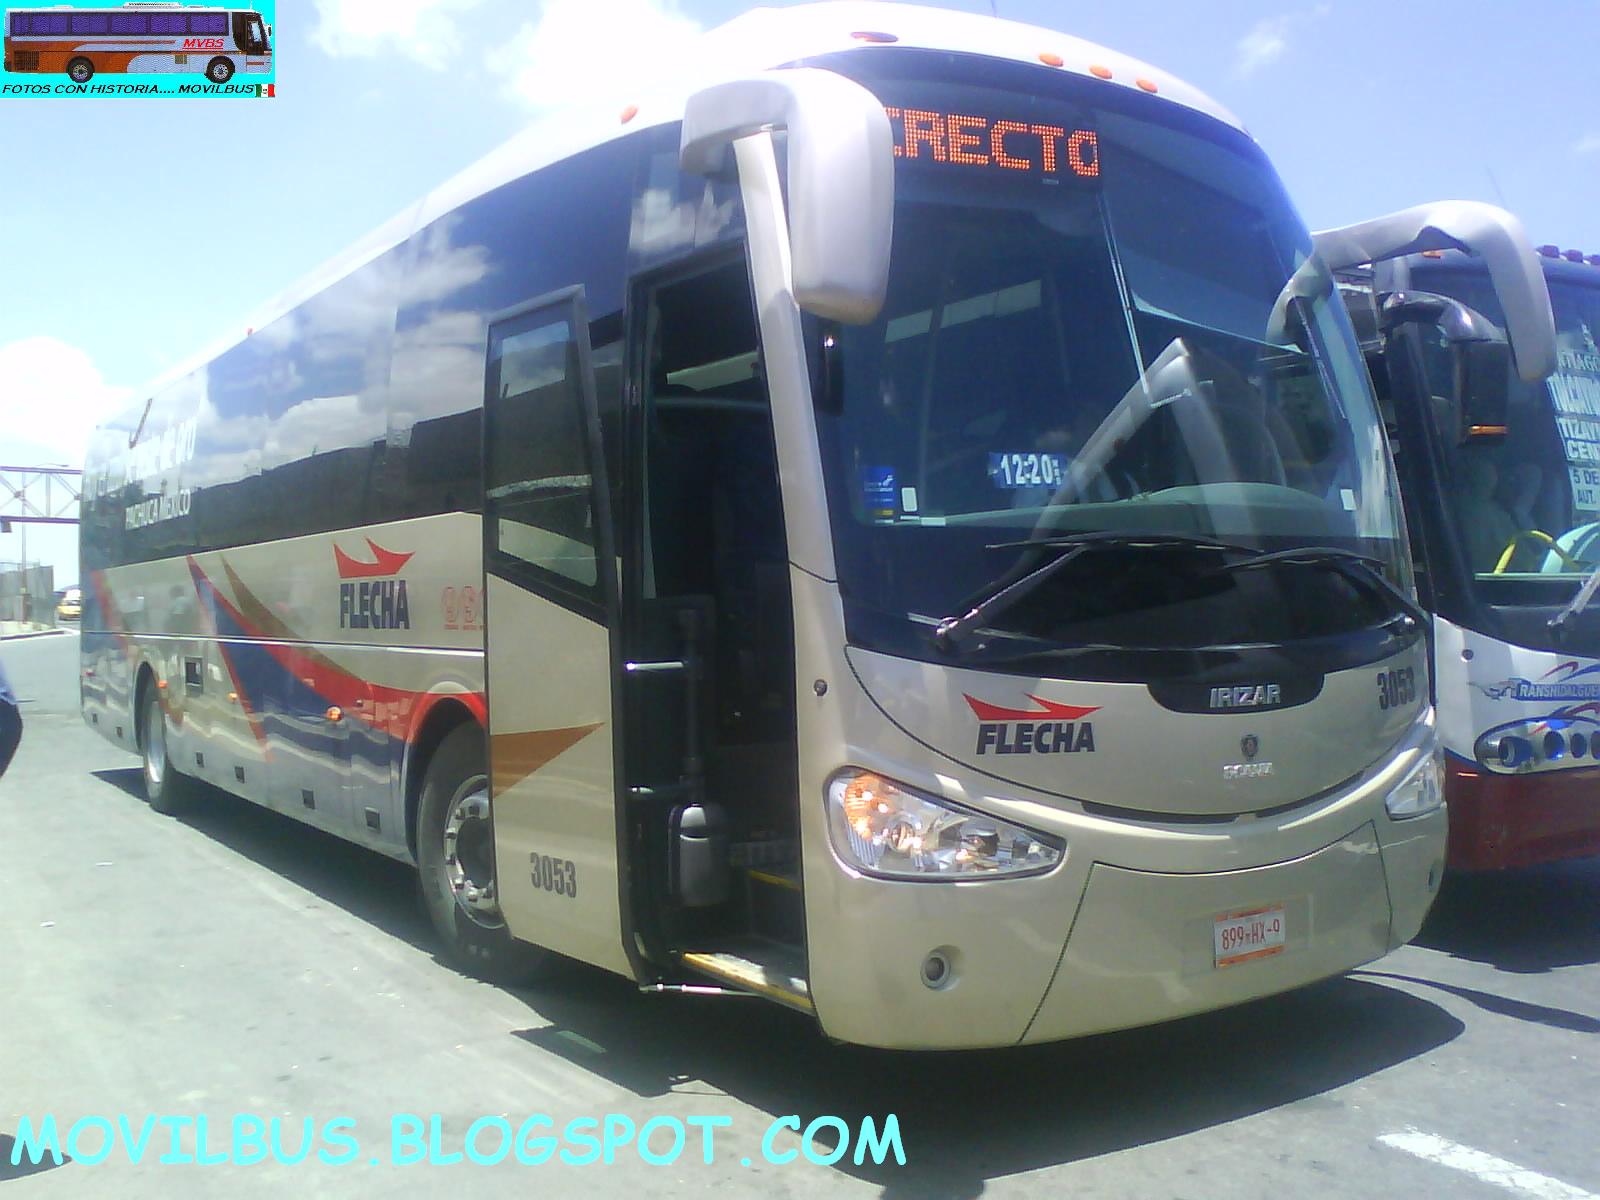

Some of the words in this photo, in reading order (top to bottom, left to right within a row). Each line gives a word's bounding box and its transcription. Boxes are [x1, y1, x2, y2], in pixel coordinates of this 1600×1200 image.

[1001, 454, 1050, 485] 12:20
[340, 580, 410, 629] FLECHA
[1209, 683, 1282, 708] IRIZAR
[1377, 666, 1415, 710] 3053
[976, 722, 1095, 755] FLECHA
[530, 852, 577, 898] 3053
